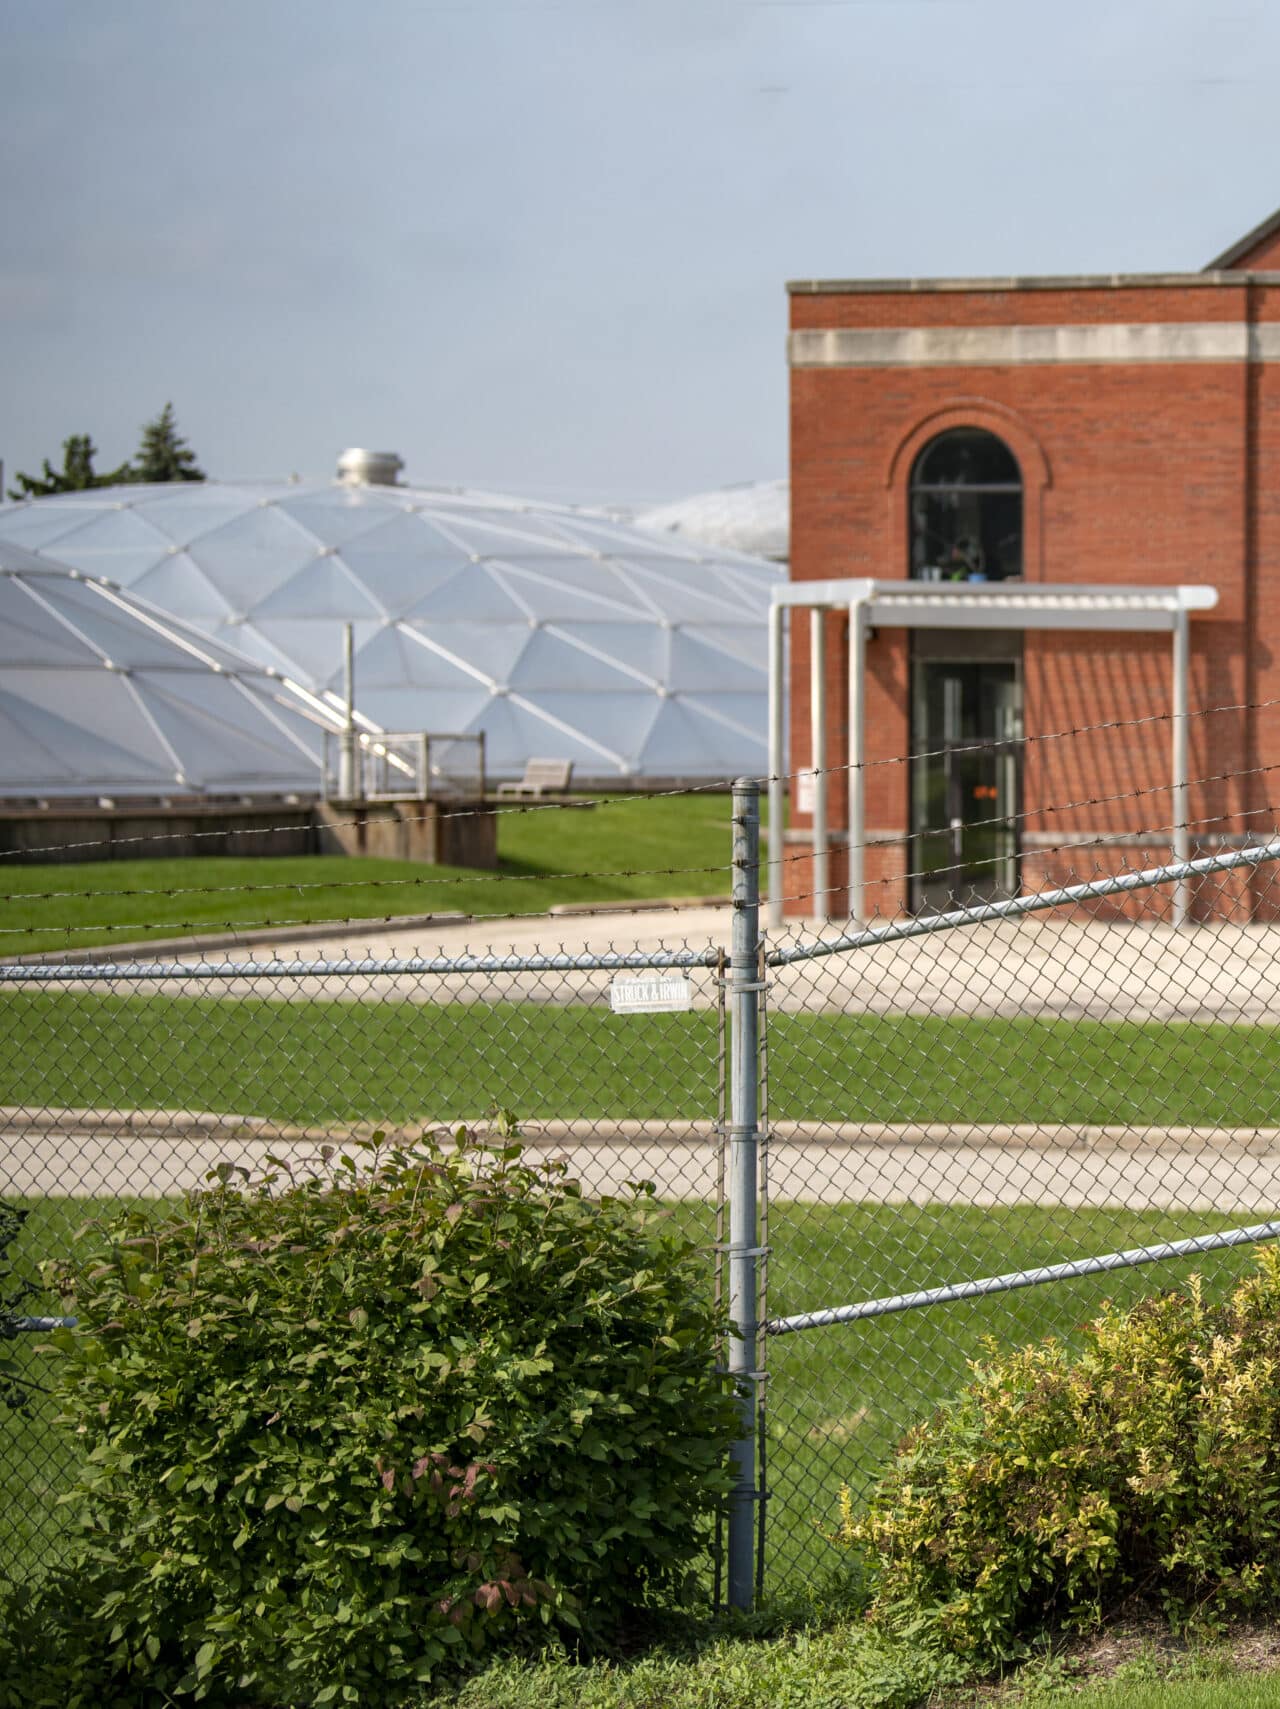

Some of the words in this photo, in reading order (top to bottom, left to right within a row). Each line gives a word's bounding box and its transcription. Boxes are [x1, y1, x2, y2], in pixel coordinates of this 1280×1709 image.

[614, 983, 649, 1002] STRUCK
[651, 983, 659, 1001] &
[659, 982, 688, 1001] IRWIN
